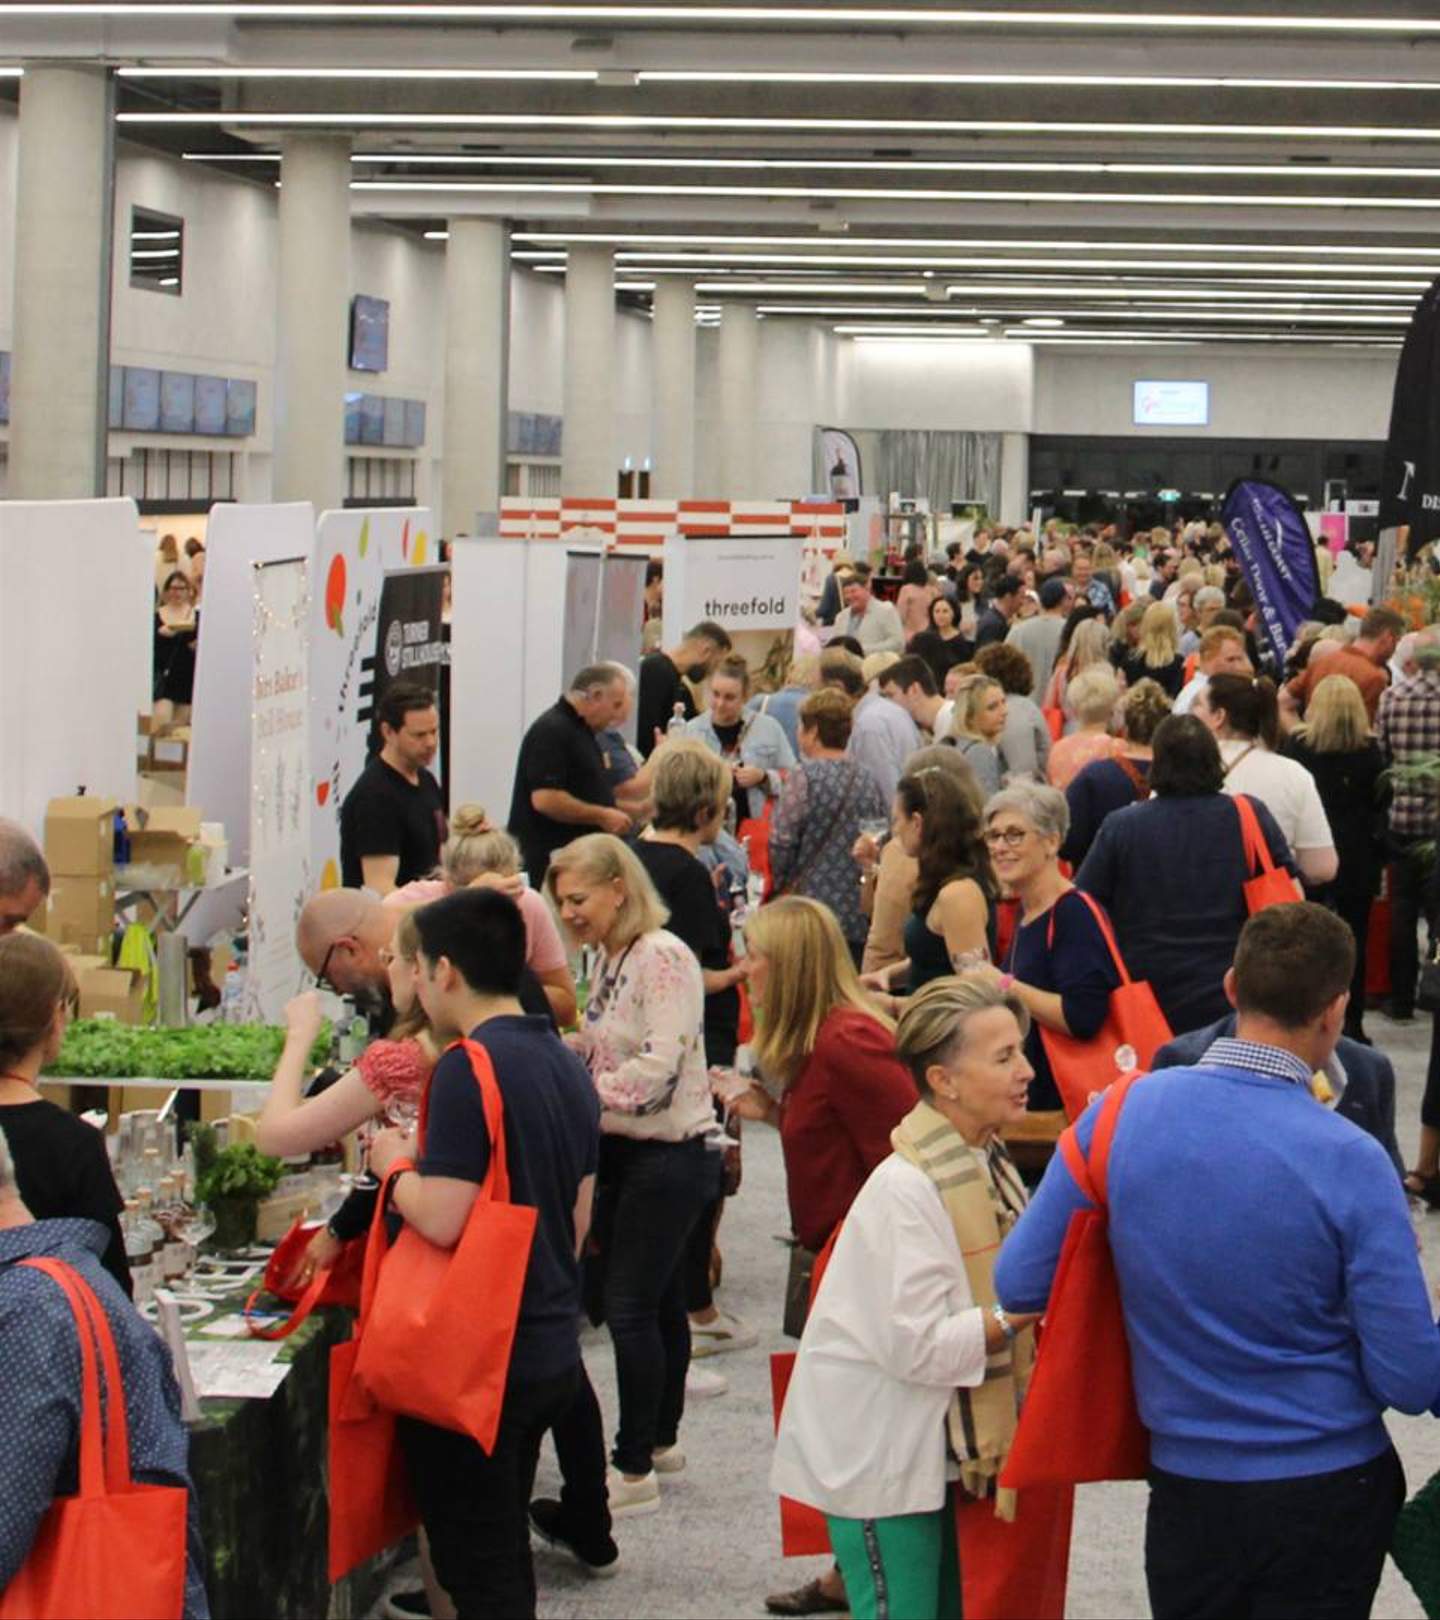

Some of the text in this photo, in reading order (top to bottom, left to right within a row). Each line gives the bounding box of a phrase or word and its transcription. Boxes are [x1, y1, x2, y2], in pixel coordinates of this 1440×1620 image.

[705, 596, 786, 616] threefold
[1262, 606, 1276, 621] &
[1269, 623, 1288, 650] Bar
